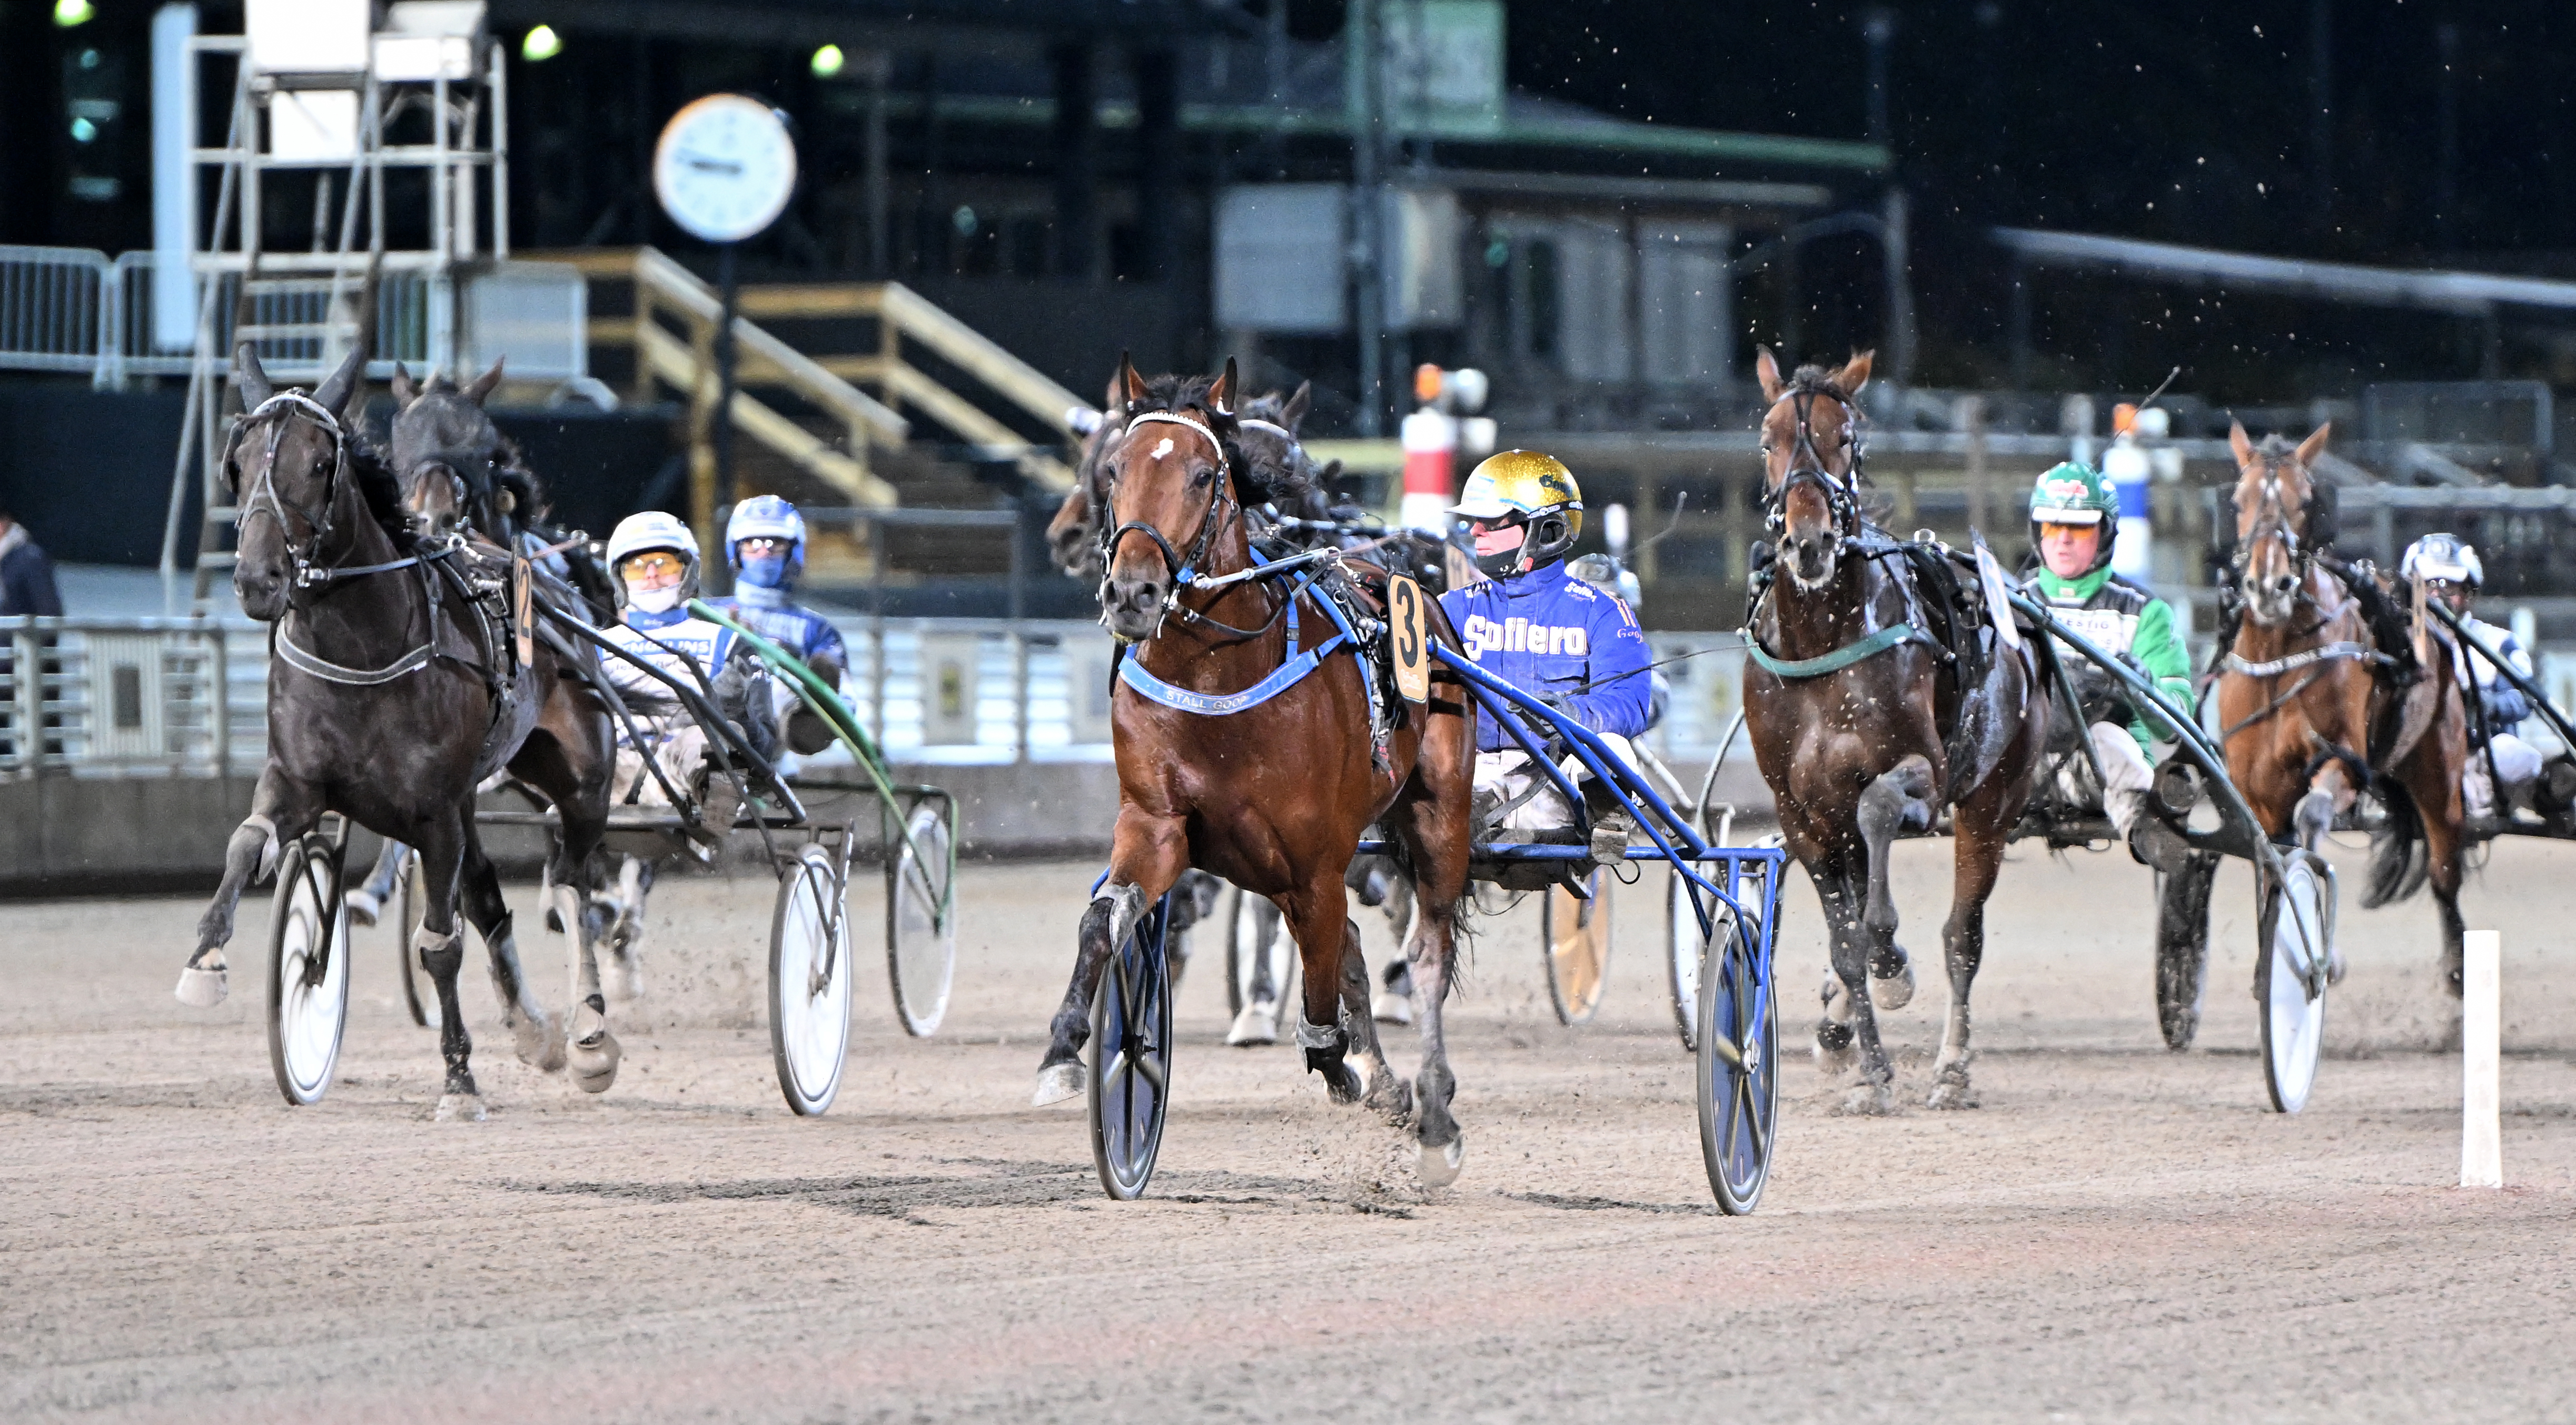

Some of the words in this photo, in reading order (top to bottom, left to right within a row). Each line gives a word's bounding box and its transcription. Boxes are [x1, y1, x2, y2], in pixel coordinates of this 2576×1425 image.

[520, 565, 530, 638] 2
[1396, 580, 1419, 668] 3
[1463, 614, 1587, 661] Sofiero
[1166, 690, 1206, 708] STALL
